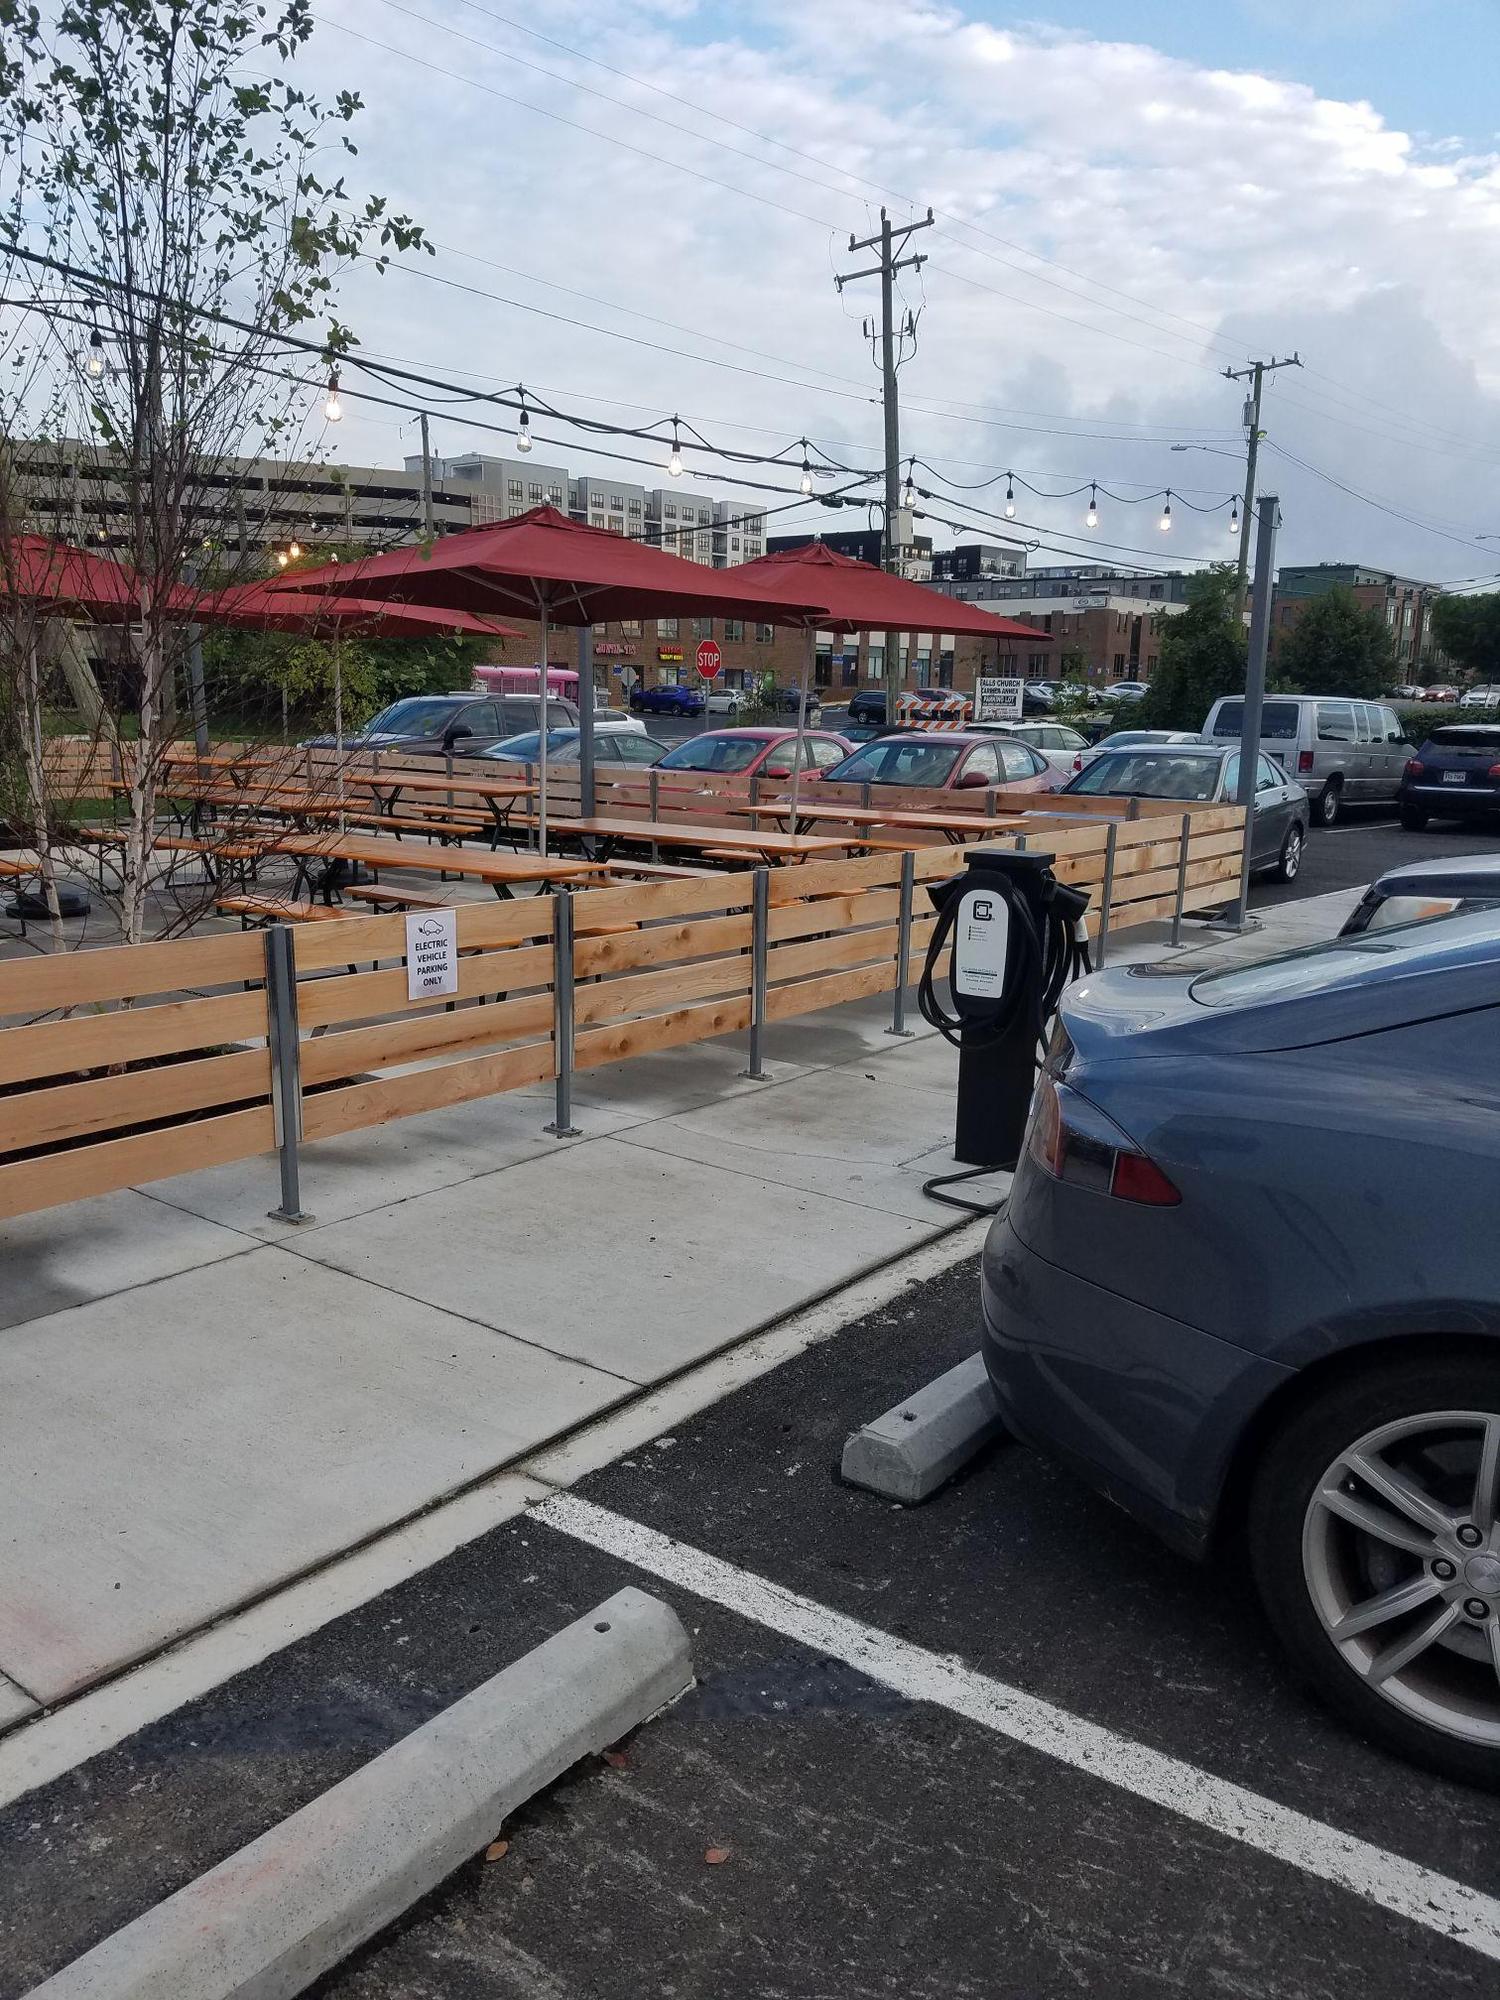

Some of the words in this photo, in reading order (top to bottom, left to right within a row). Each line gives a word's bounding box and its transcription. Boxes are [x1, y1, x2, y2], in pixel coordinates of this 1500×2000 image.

[698, 652, 719, 667] STOP
[997, 679, 1021, 687] CHURCH
[415, 939, 448, 951] ELECTRIC
[417, 951, 447, 962] VEHICLE
[417, 963, 448, 975] PARKING
[423, 976, 443, 987] ONLY
